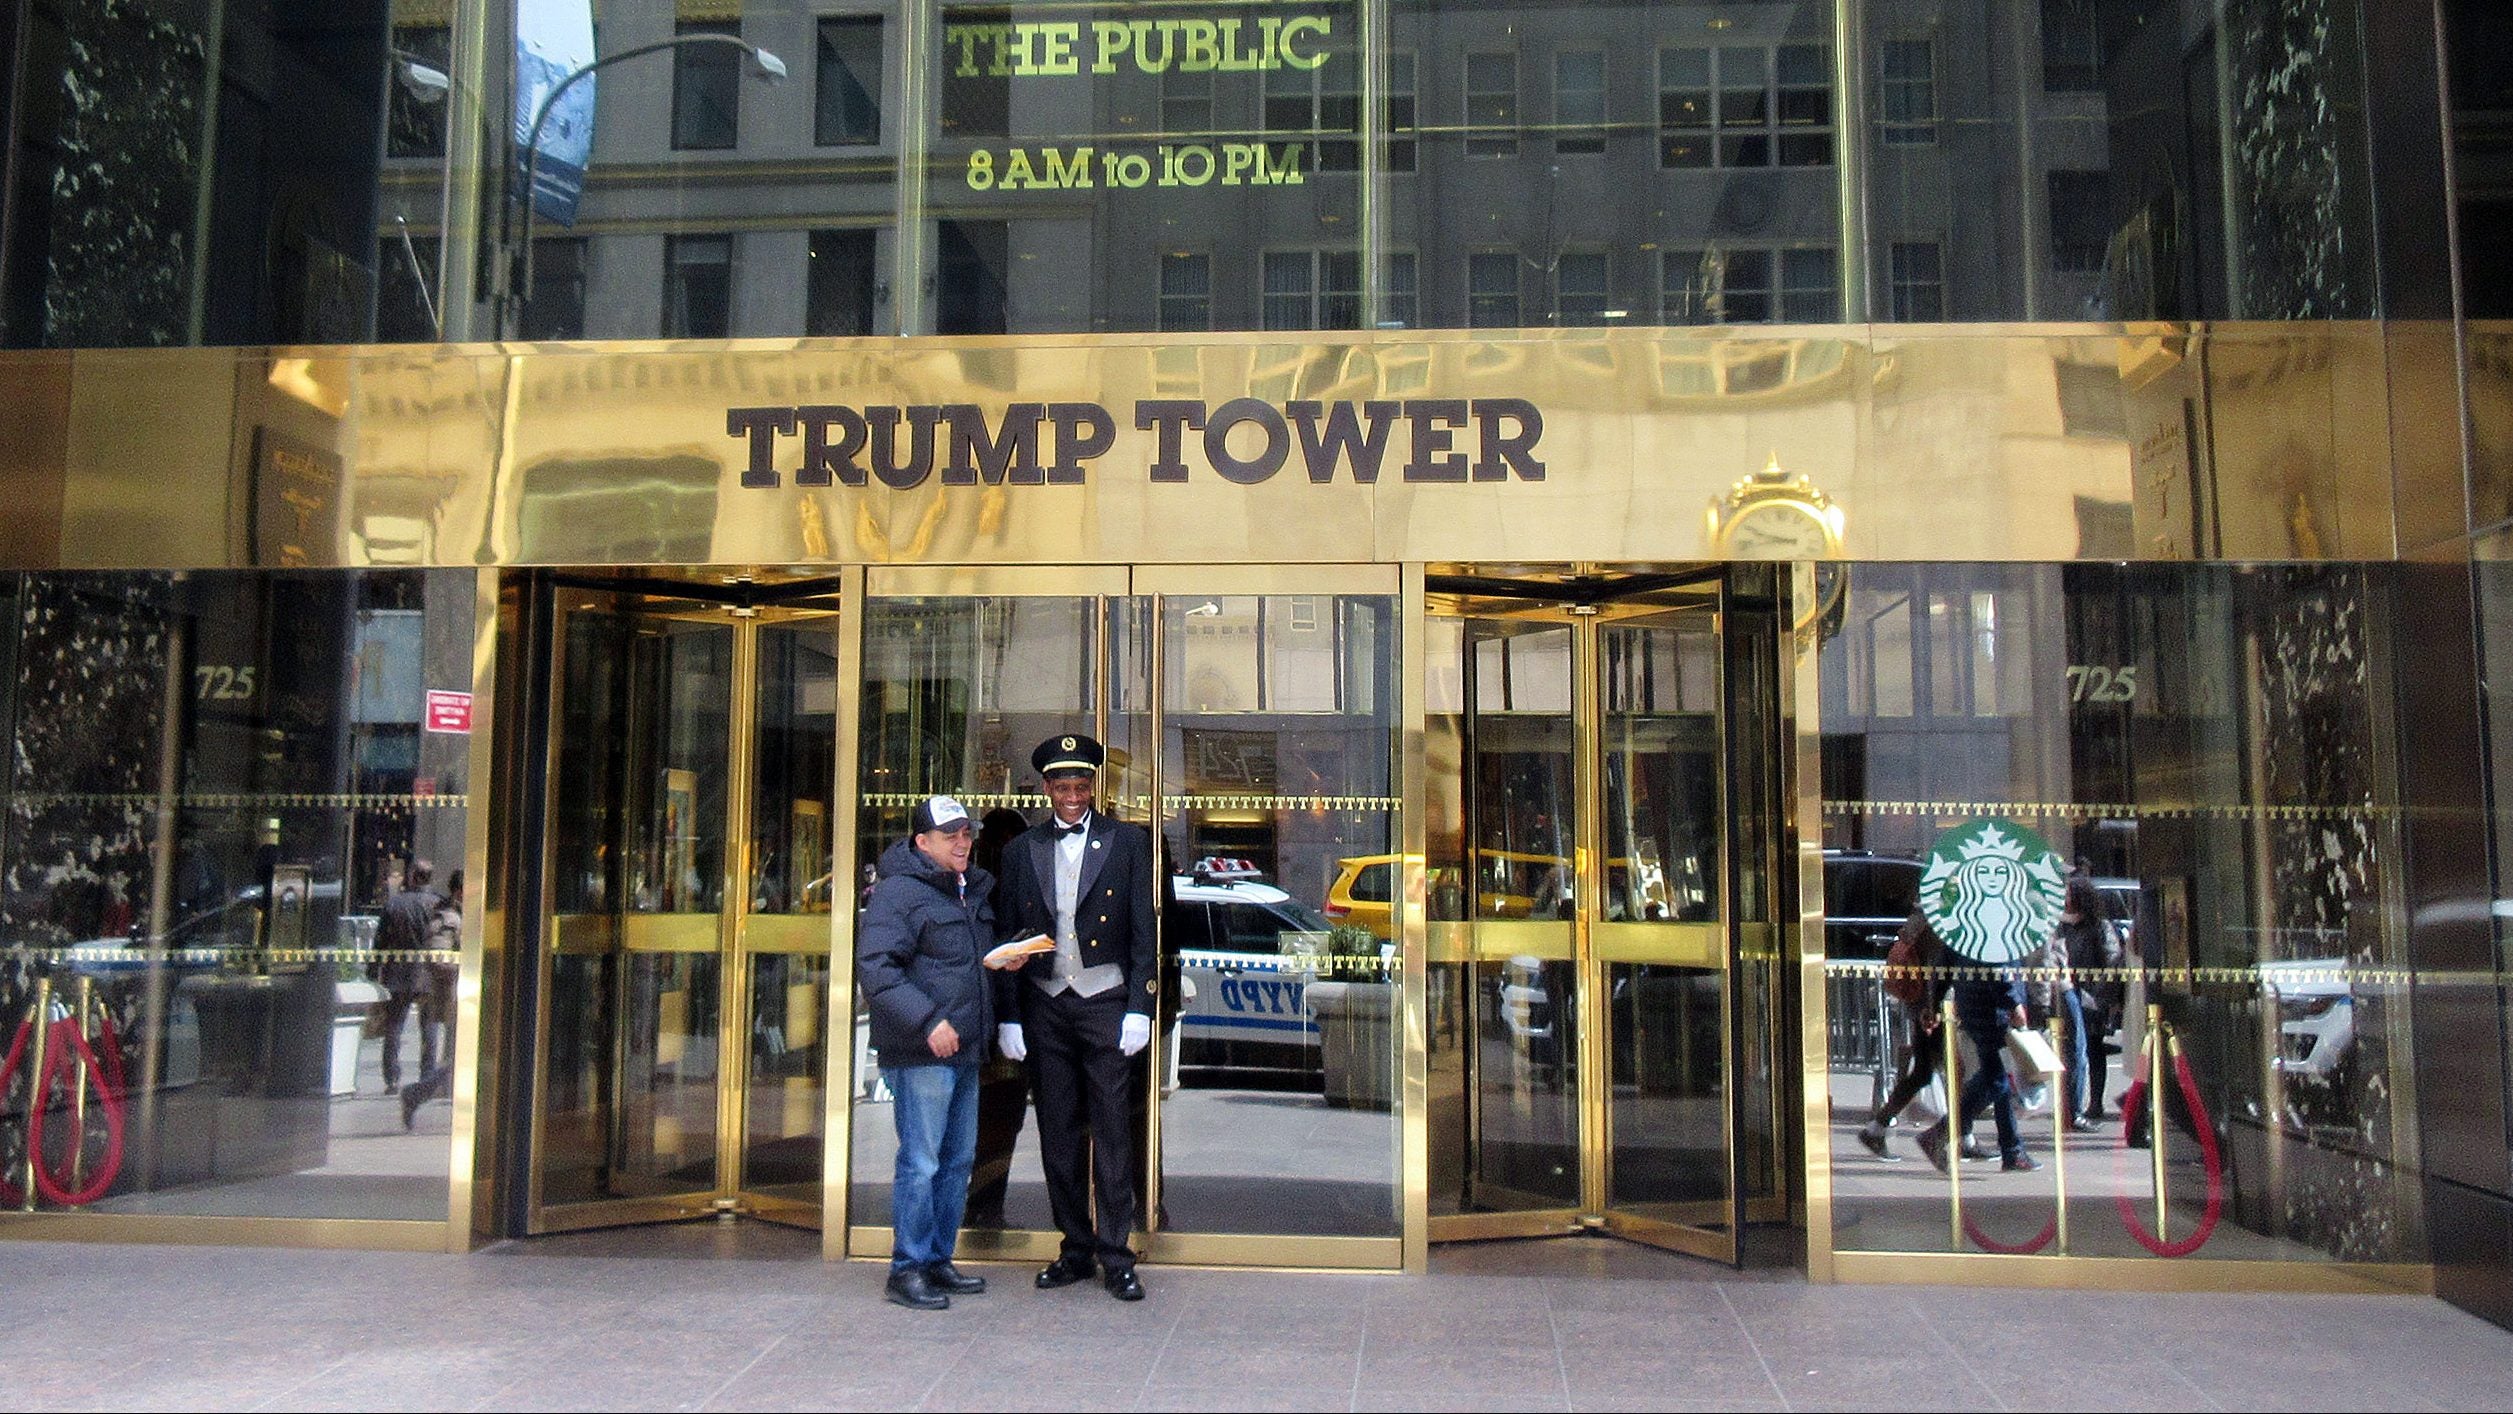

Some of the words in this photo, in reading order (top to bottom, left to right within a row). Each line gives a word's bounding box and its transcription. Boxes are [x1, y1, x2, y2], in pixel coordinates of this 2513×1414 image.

[947, 22, 1080, 77] THE
[1091, 16, 1332, 74] PUBLIC
[1103, 152, 1151, 188] to
[726, 402, 1117, 490] TRUMP
[1135, 397, 1547, 484] TOWER
[195, 666, 256, 699] 725
[2066, 665, 2138, 702] 725
